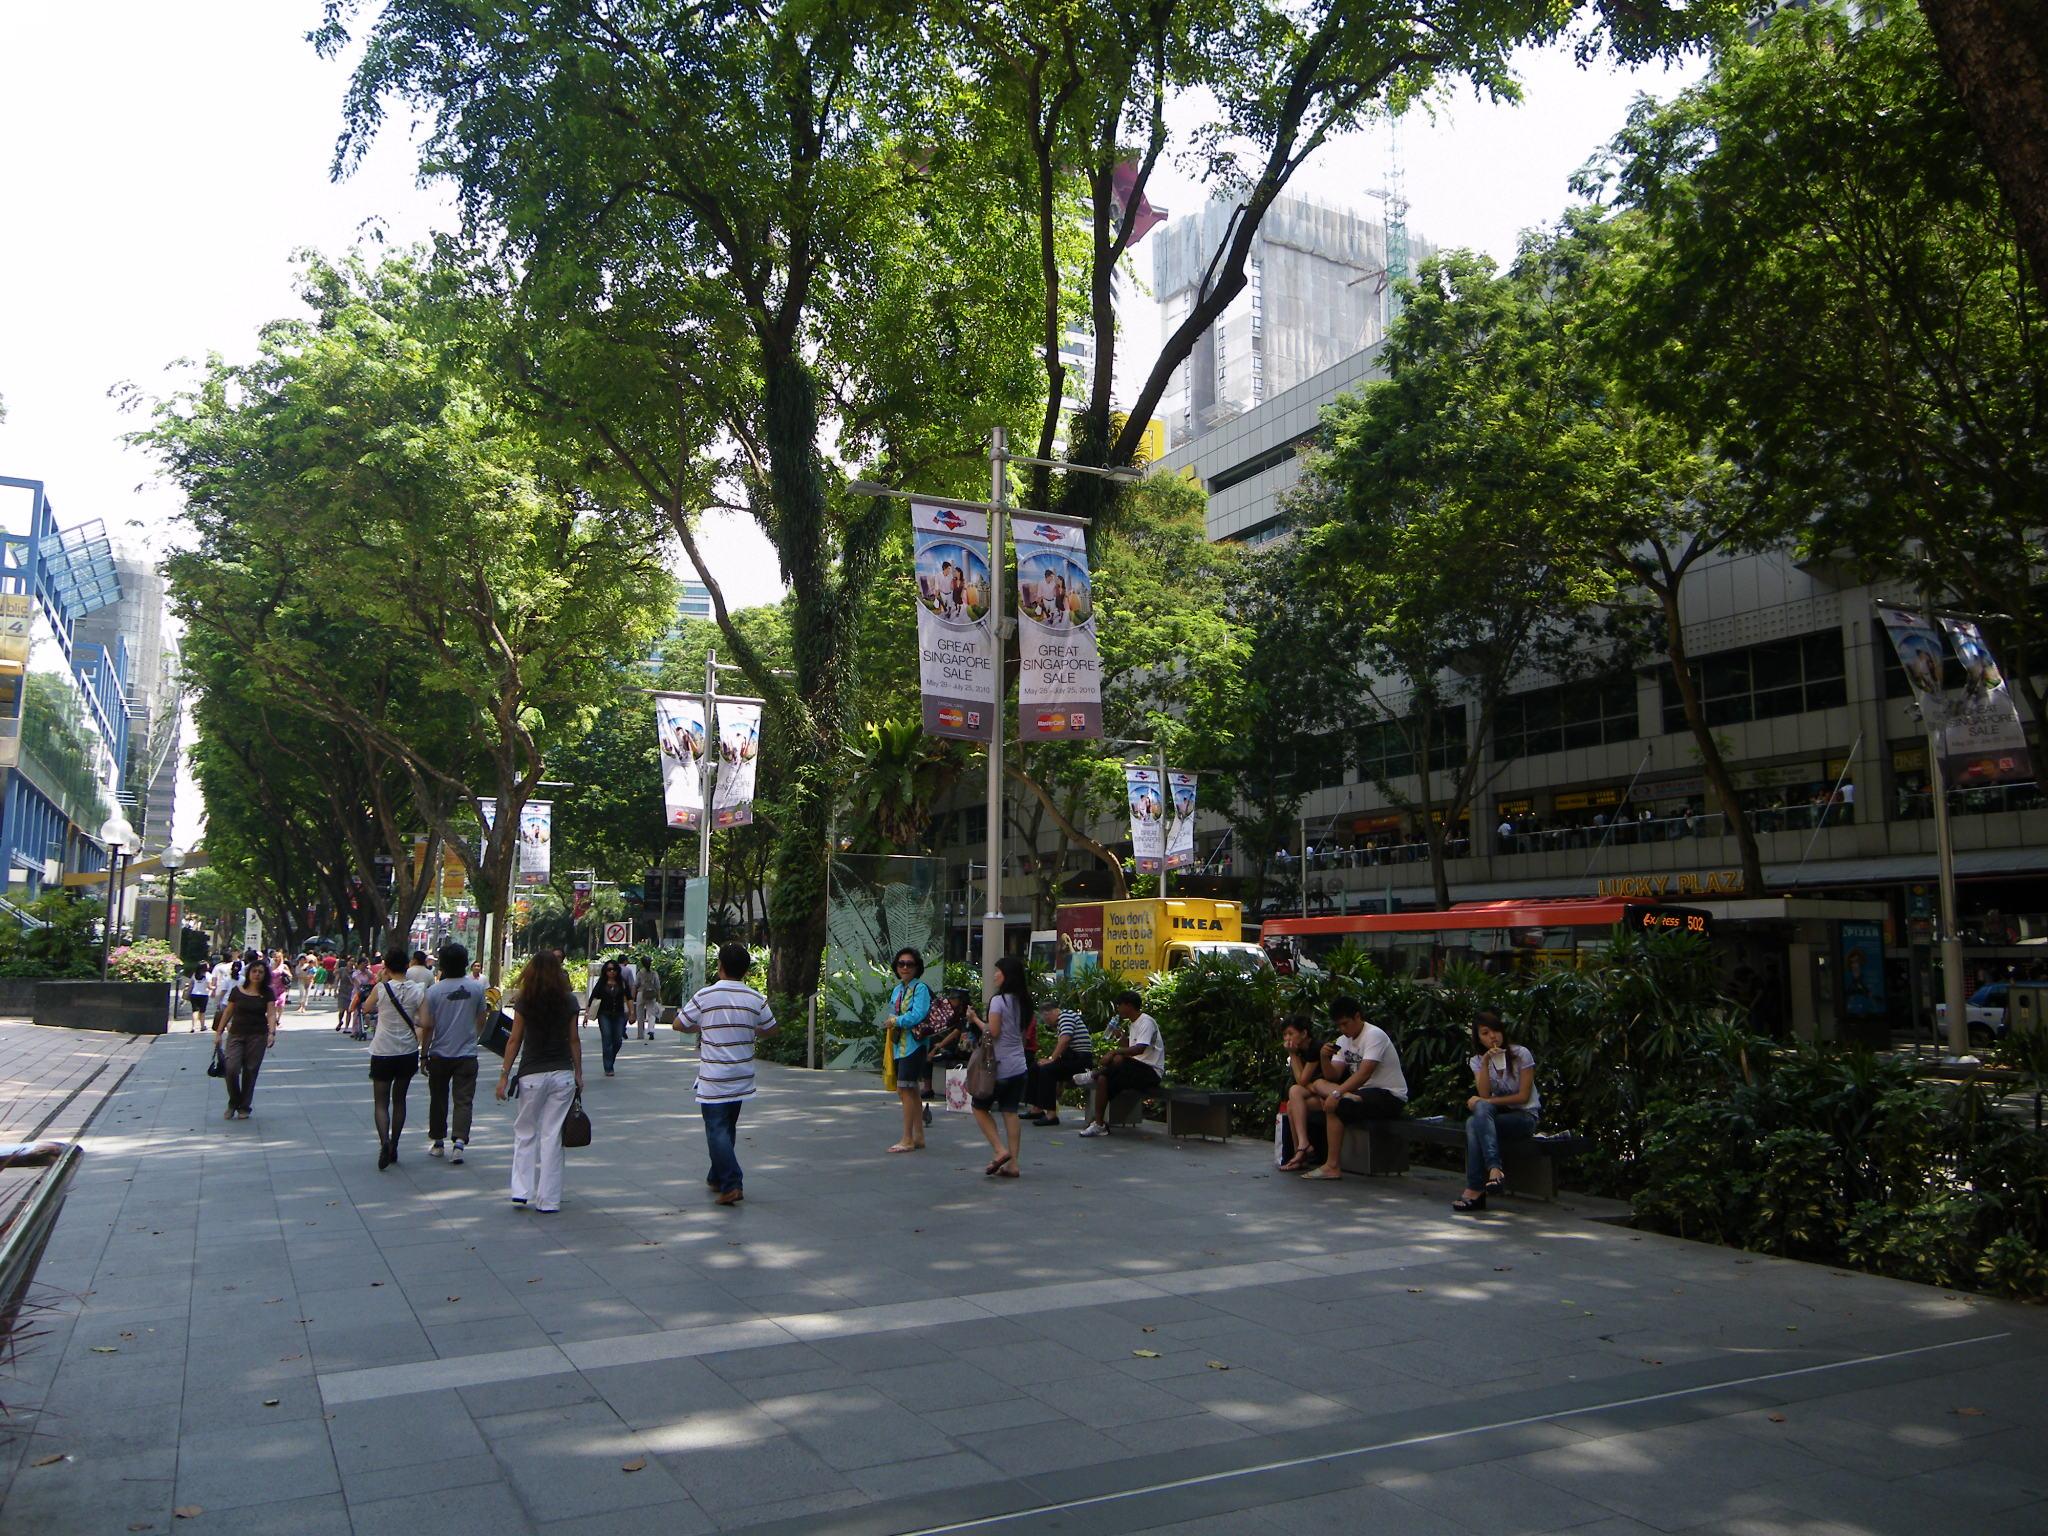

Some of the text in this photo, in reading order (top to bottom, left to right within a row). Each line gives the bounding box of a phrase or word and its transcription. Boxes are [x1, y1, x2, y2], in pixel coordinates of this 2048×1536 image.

[937, 638, 976, 654] GREAT
[1038, 644, 1079, 658] GREAT
[923, 650, 991, 670] SINGAPORE
[1023, 659, 1095, 671] SINGAPORE
[943, 666, 973, 682] SALE
[1043, 672, 1076, 684] SALE
[926, 679, 939, 688] May
[953, 683, 963, 692] July
[975, 685, 991, 694] 2010
[1024, 688, 1037, 696] May
[1054, 687, 1066, 695] July
[1079, 687, 1096, 695] 2010
[1968, 725, 2000, 737] SALE
[1598, 874, 1670, 897] LUCKY
[1110, 911, 1150, 926] You don't
[1173, 917, 1223, 930] IKEA
[1687, 915, 1705, 931] 502
[1107, 927, 1129, 940] have
[1129, 928, 1140, 940] to
[1141, 927, 1153, 939] be
[1115, 941, 1145, 954] rich to
[1110, 956, 1151, 970] be clever.
